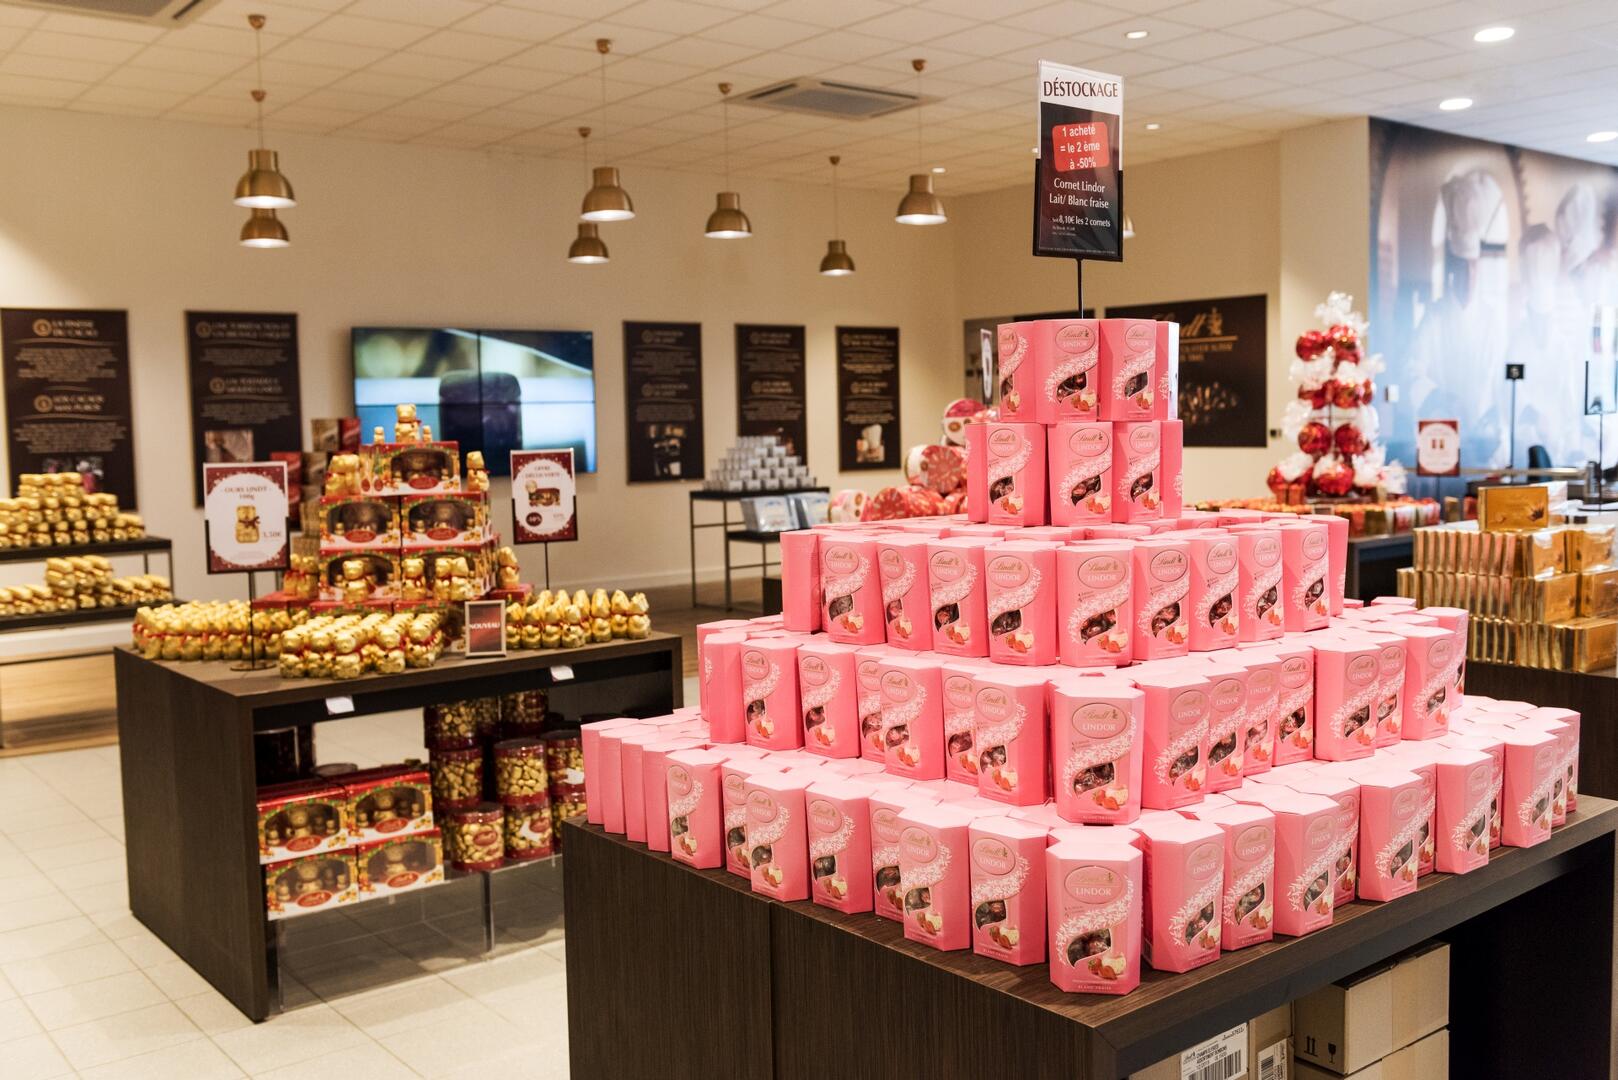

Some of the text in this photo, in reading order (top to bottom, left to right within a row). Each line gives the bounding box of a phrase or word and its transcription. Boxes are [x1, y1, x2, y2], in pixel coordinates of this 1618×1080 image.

[1043, 76, 1118, 98] DÉSTOCKAGE
[1062, 126, 1096, 137] 1 acheté
[1068, 142, 1075, 153] le
[1076, 142, 1082, 152] 2
[1084, 141, 1100, 152] ème
[1069, 157, 1096, 170] à -50%
[1054, 178, 1106, 193] Cornet Lindor
[1049, 193, 1109, 209] Lait/ Blanc fraise
[1058, 214, 1075, 224] 8,10€
[1075, 216, 1084, 225] les
[1084, 217, 1089, 226] 2
[1090, 219, 1110, 228] cornets
[994, 562, 1016, 571] Lindt
[1089, 562, 1112, 571] Lindt
[1178, 710, 1200, 718] LINDOR
[1242, 845, 1266, 856] LINDOR
[1194, 862, 1216, 873] LINDOR
[1076, 887, 1112, 896] LINDOR
